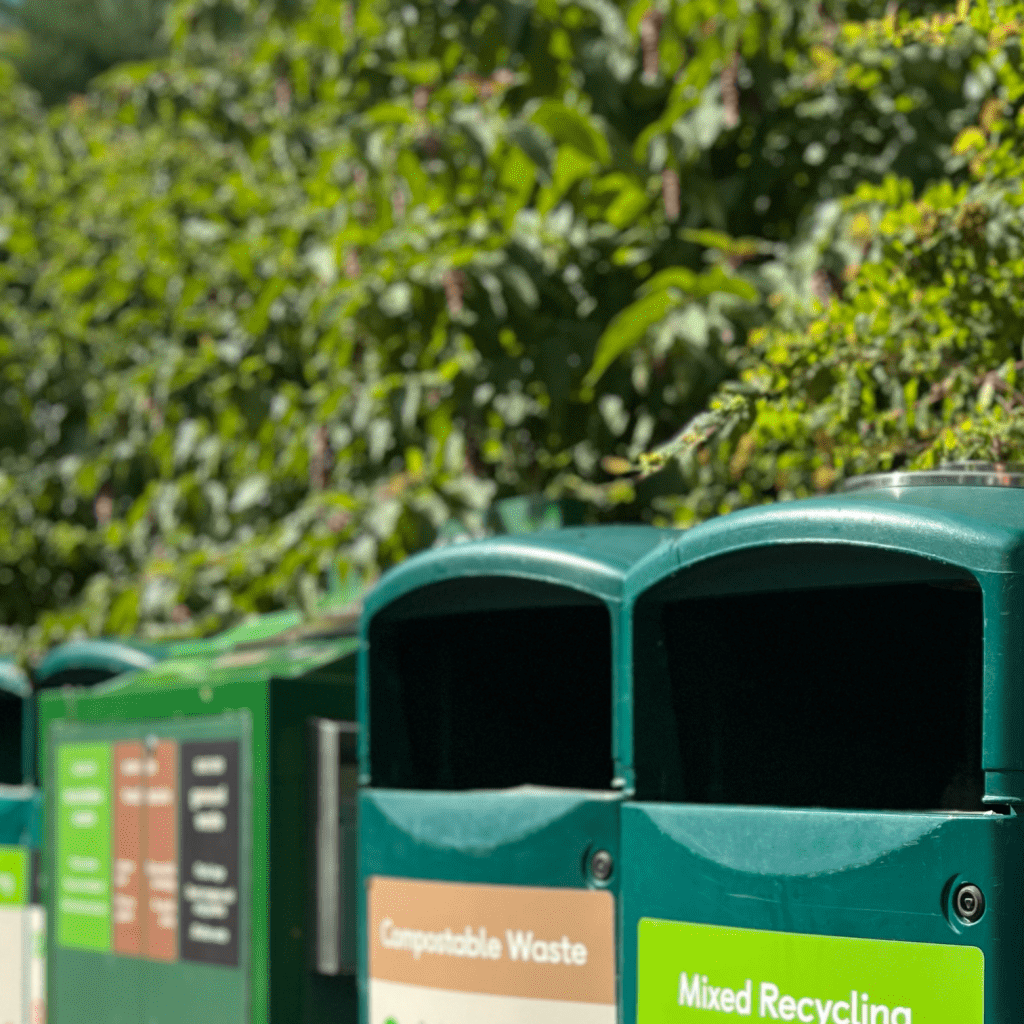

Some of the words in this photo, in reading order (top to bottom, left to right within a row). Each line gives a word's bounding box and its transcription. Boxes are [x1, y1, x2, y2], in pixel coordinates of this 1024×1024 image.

[379, 917, 503, 960] Compostable
[505, 928, 588, 966] Waste
[678, 971, 752, 1016] Mixed
